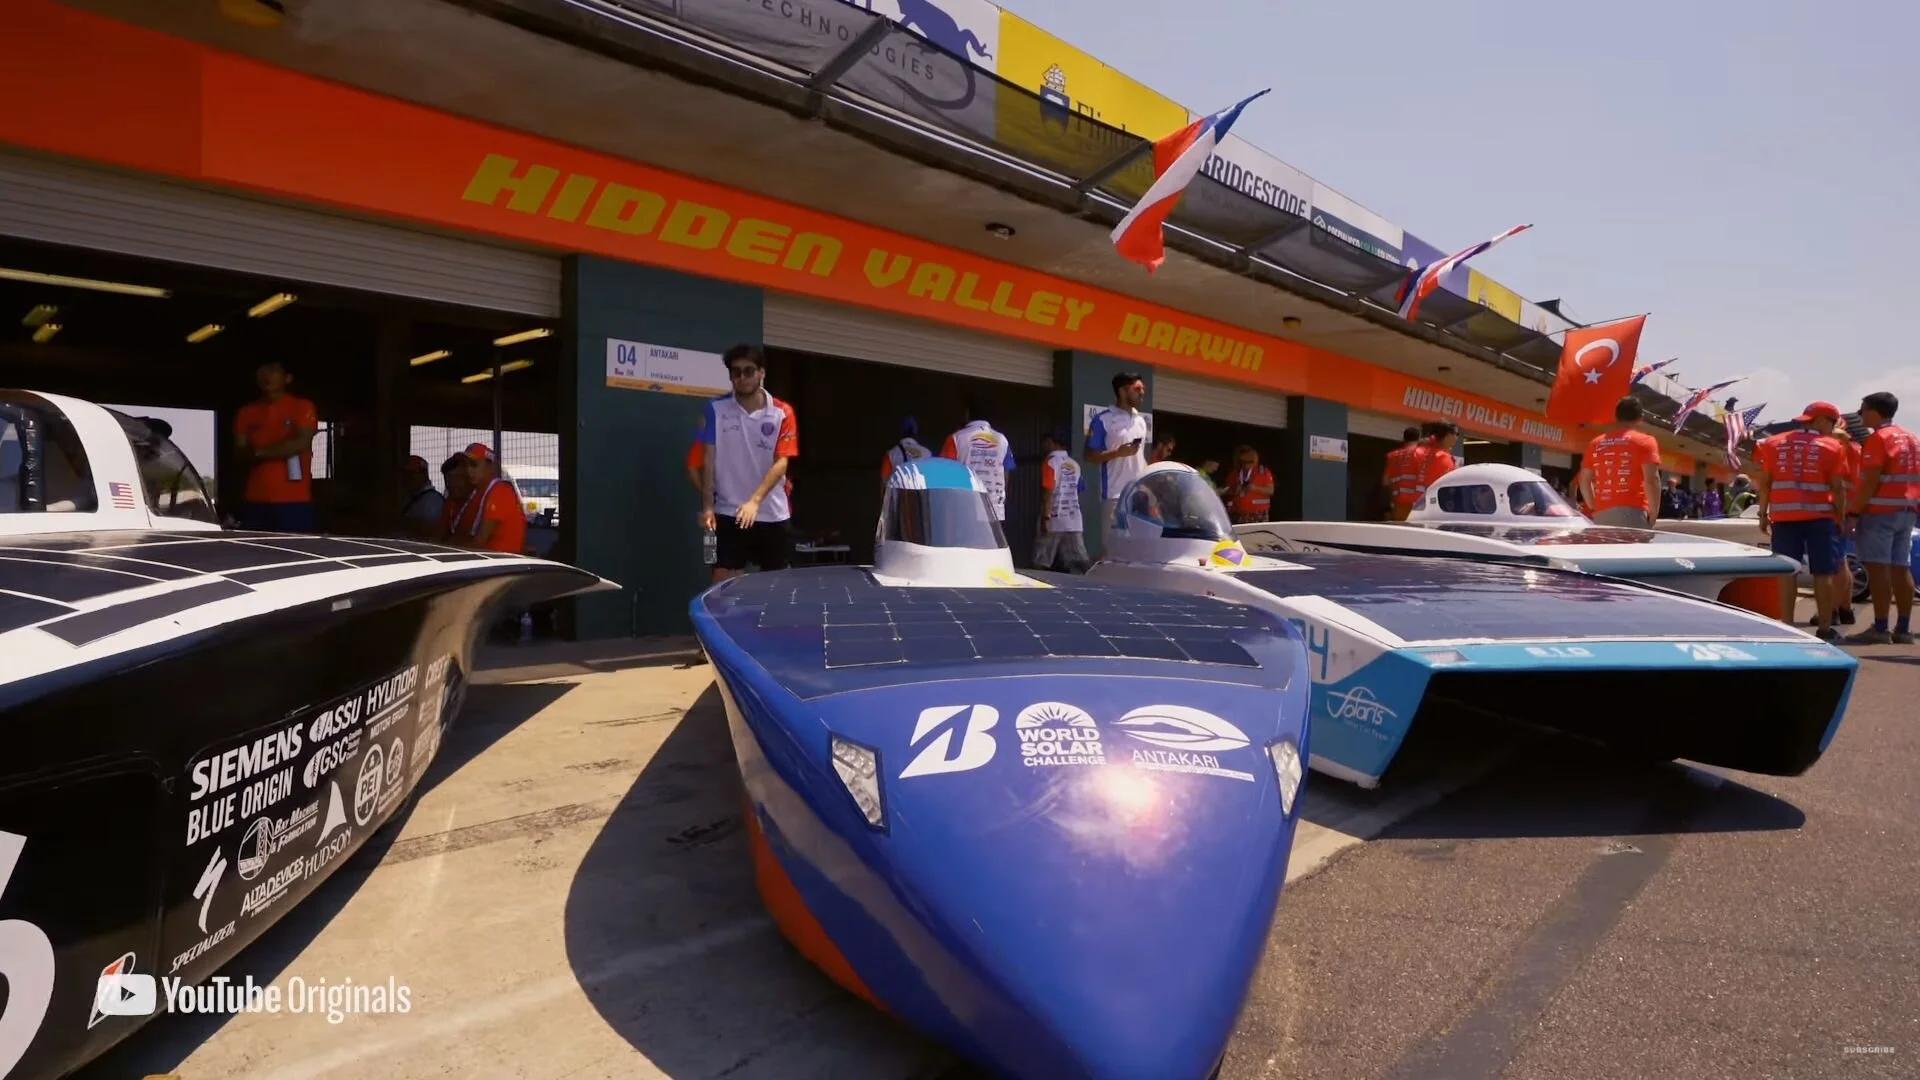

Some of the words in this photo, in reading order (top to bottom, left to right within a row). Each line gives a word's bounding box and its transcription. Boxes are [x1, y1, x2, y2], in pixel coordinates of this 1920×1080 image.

[746, 0, 935, 81] ECHNOOGIES
[461, 153, 843, 276] HIDDEN
[863, 248, 1095, 331] VALLEY
[1118, 312, 1265, 371] DARWIN
[617, 343, 637, 366] 04
[649, 348, 679, 361] ANTAKARI
[1403, 386, 1464, 418] HIDDEN
[1466, 402, 1517, 430] VALLEY
[1522, 418, 1564, 442] DARWIN
[366, 664, 419, 715] HYUNDAI
[321, 695, 363, 740] ASSU
[1016, 728, 1100, 742] WORLD
[190, 722, 304, 801] SIEMENS
[320, 736, 349, 775] GSC
[1020, 741, 1104, 757] SOLAR
[1023, 756, 1107, 767] CHALLENGE
[1133, 749, 1220, 769] ANTAKARI
[186, 792, 238, 846] BLUE
[240, 765, 294, 819] ORIGIN
[303, 826, 352, 881] HUDSON
[168, 920, 235, 974] SPECIALIZED
